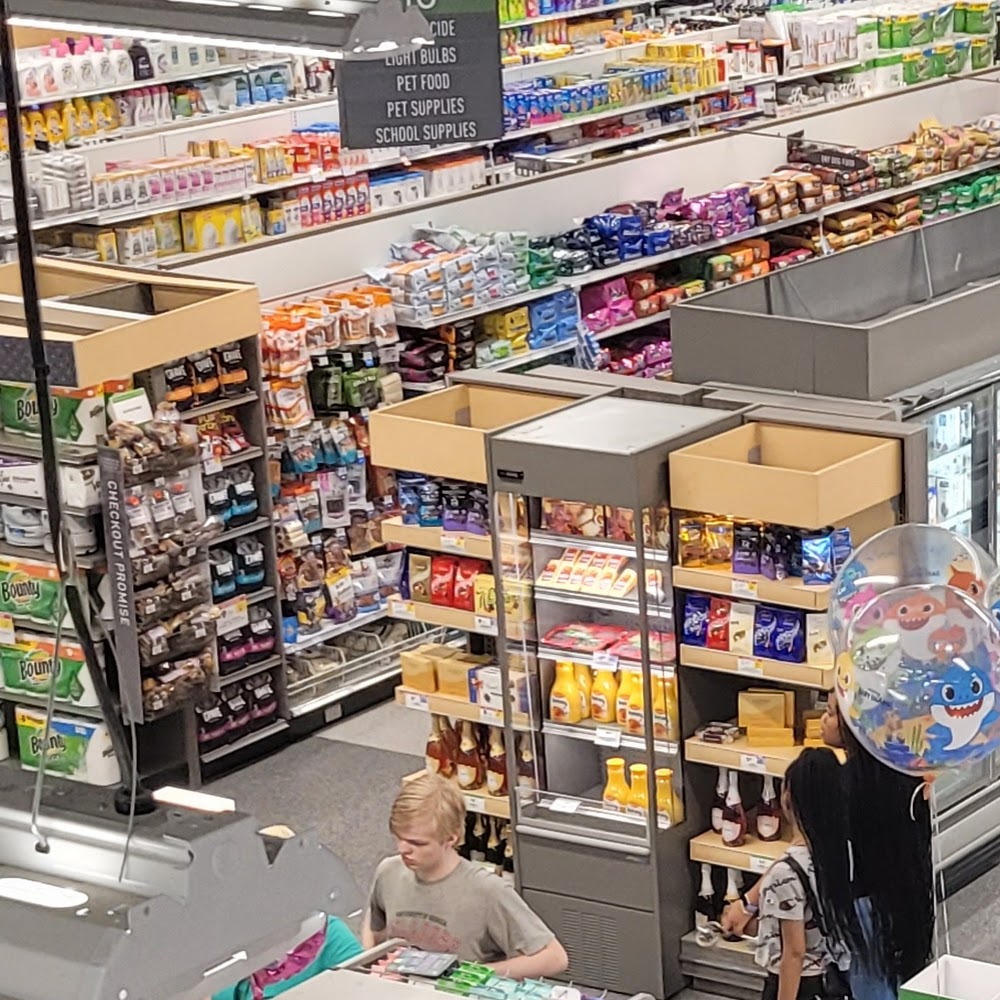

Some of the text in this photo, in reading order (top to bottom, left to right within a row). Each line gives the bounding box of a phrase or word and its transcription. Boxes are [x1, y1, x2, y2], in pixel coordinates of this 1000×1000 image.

[430, 20, 456, 37] CIDE
[420, 47, 457, 65] BULBS
[397, 73, 450, 92] PET FOOD
[387, 97, 465, 118] PET SUPPLIES
[375, 121, 477, 144] SCHOOL SUPPLIES
[106, 480, 124, 559] CHECKOUT
[1, 578, 40, 600] Bounty
[115, 562, 130, 627] PROMISE
